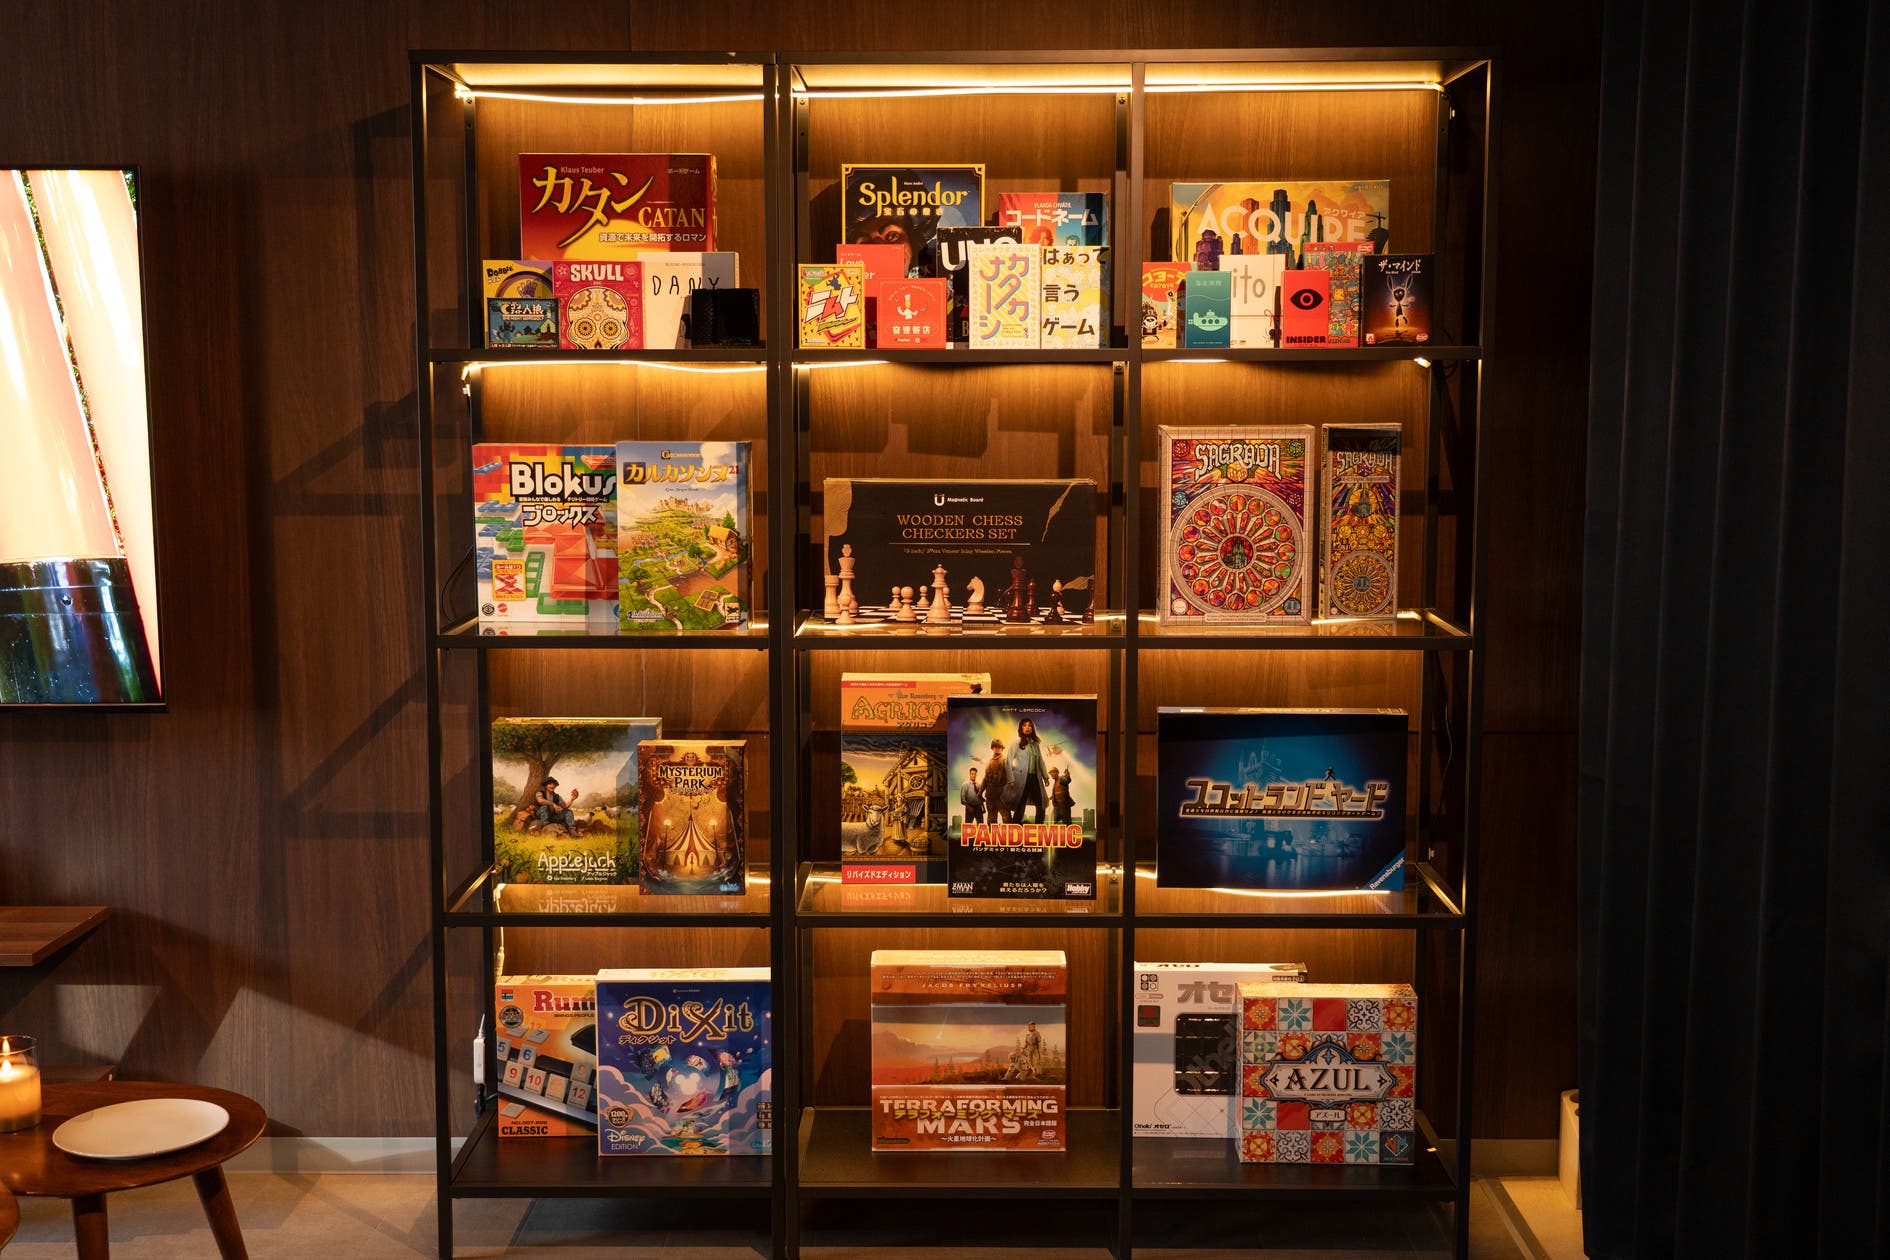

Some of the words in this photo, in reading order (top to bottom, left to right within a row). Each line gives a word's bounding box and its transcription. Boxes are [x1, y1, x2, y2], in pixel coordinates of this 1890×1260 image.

[560, 166, 580, 174] Klaus
[581, 166, 604, 174] Teuber
[858, 175, 968, 218] Splendor
[531, 166, 654, 249] カタン
[638, 206, 706, 228] CATAN
[1006, 209, 1099, 227] コードネーム
[1197, 202, 1366, 245] ACQUIRE
[1043, 247, 1109, 265] はぁって
[570, 263, 624, 282] SKULL
[1233, 264, 1266, 304] ito
[1043, 284, 1080, 303] 言う
[1042, 317, 1095, 336] ゲーム
[1286, 336, 1326, 344] INSIDER
[1194, 443, 1283, 482] SAGRADA
[510, 462, 616, 500] Blokus
[625, 463, 729, 483] カルカソンヌ
[522, 504, 599, 530] ブロックス
[897, 514, 964, 526] WOODEN
[972, 514, 1024, 526] CHESS
[902, 528, 985, 539] CHECKERS
[988, 528, 1017, 539] SET
[851, 696, 947, 723] AGRICO
[659, 765, 723, 779] MYSTERIUM
[674, 777, 711, 790] PARK
[960, 823, 1083, 848] PANDEMIC
[537, 851, 616, 874] Applejack
[846, 870, 911, 879] リバイズドエディション
[533, 990, 595, 1012] Rum
[1177, 981, 1233, 1004] オセ
[618, 1034, 677, 1045] ディクシット
[523, 1049, 532, 1061] 6
[509, 1067, 517, 1080] 9
[528, 1073, 542, 1086] 10
[1284, 1068, 1370, 1091] AZUL
[572, 1086, 586, 1100] 12
[879, 1100, 1058, 1114] TERRAFORMING
[1314, 1111, 1341, 1119] アズール
[501, 1126, 549, 1135] CLASSIC
[917, 1117, 1021, 1134] MARS
[604, 1128, 646, 1146] Disney
